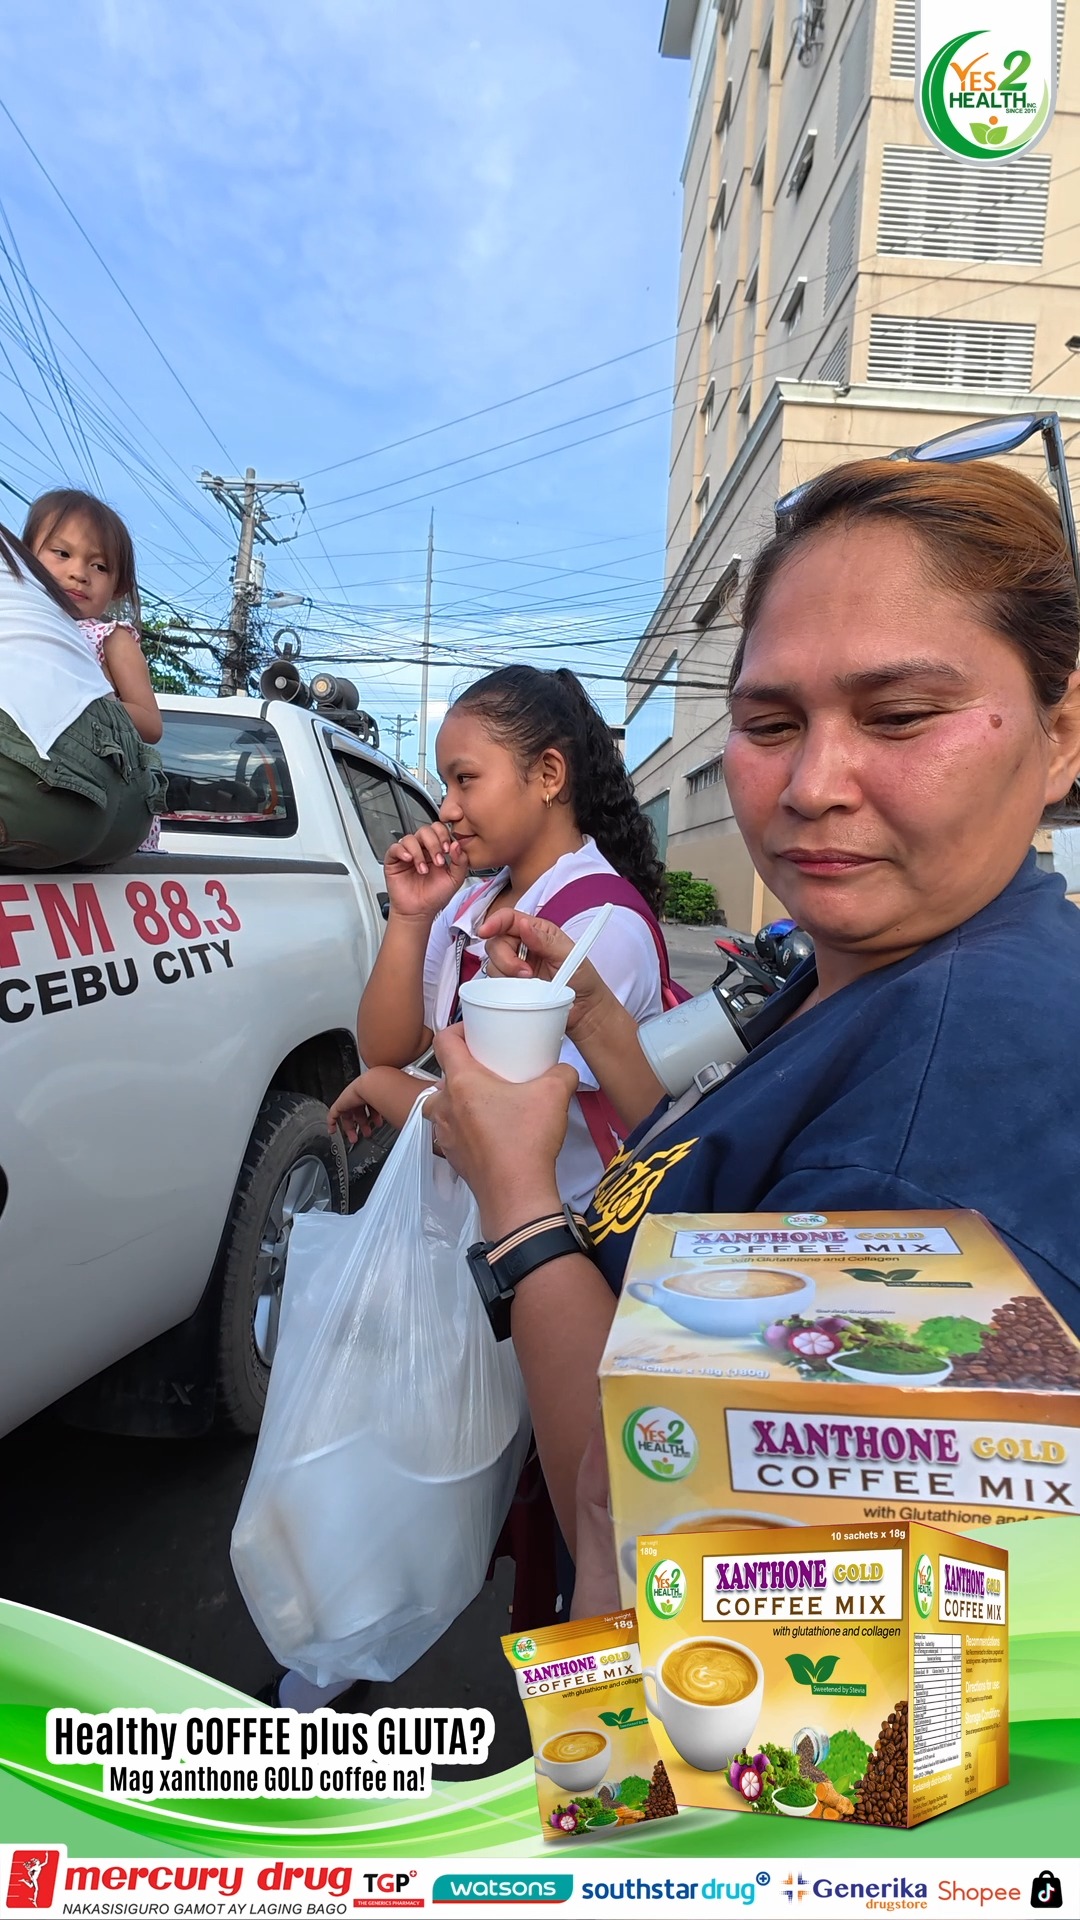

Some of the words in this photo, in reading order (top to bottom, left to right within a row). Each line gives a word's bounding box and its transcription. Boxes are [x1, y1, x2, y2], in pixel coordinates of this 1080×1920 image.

[0, 882, 116, 969] FM
[125, 880, 241, 945] 88.3
[0, 958, 139, 1024] CEBU
[153, 939, 234, 984] CITY
[692, 1244, 846, 1255] COFFEE
[864, 1243, 936, 1253] MIX
[693, 1231, 849, 1244] XANTHONE
[855, 1231, 926, 1241] GOLD
[636, 1420, 667, 1443] YES
[667, 1420, 684, 1445] 2
[752, 1420, 960, 1464] XANTHONE
[971, 1436, 1068, 1464] GOLD
[638, 1440, 684, 1455] HEALTH
[757, 1463, 955, 1497] COFFEE
[979, 1475, 1075, 1507] MIX
[864, 1506, 896, 1520] with
[899, 1506, 992, 1525] Glutathione
